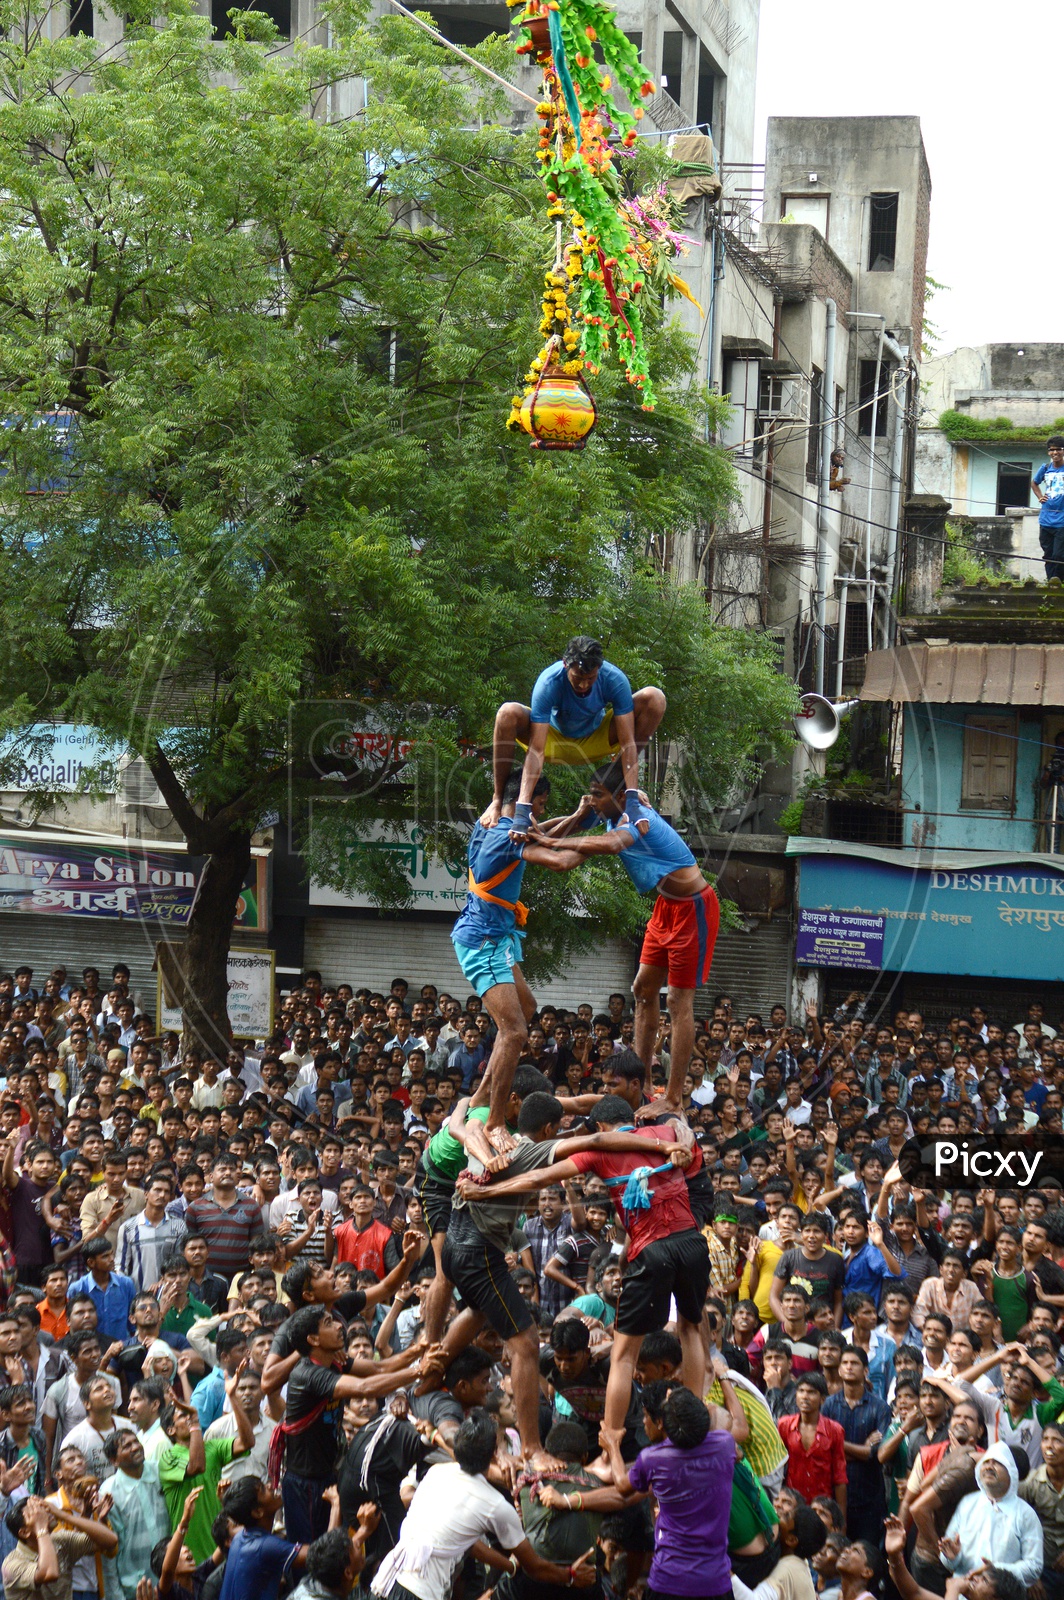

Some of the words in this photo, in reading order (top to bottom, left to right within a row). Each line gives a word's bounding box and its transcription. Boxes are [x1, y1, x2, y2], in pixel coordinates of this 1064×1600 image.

[0, 849, 81, 884] Arya
[93, 856, 196, 888] Salon
[931, 871, 1064, 895] DESHMUK
[32, 887, 137, 914] आर्य
[802, 909, 828, 924] देशमुख
[829, 912, 840, 923] नेत्र
